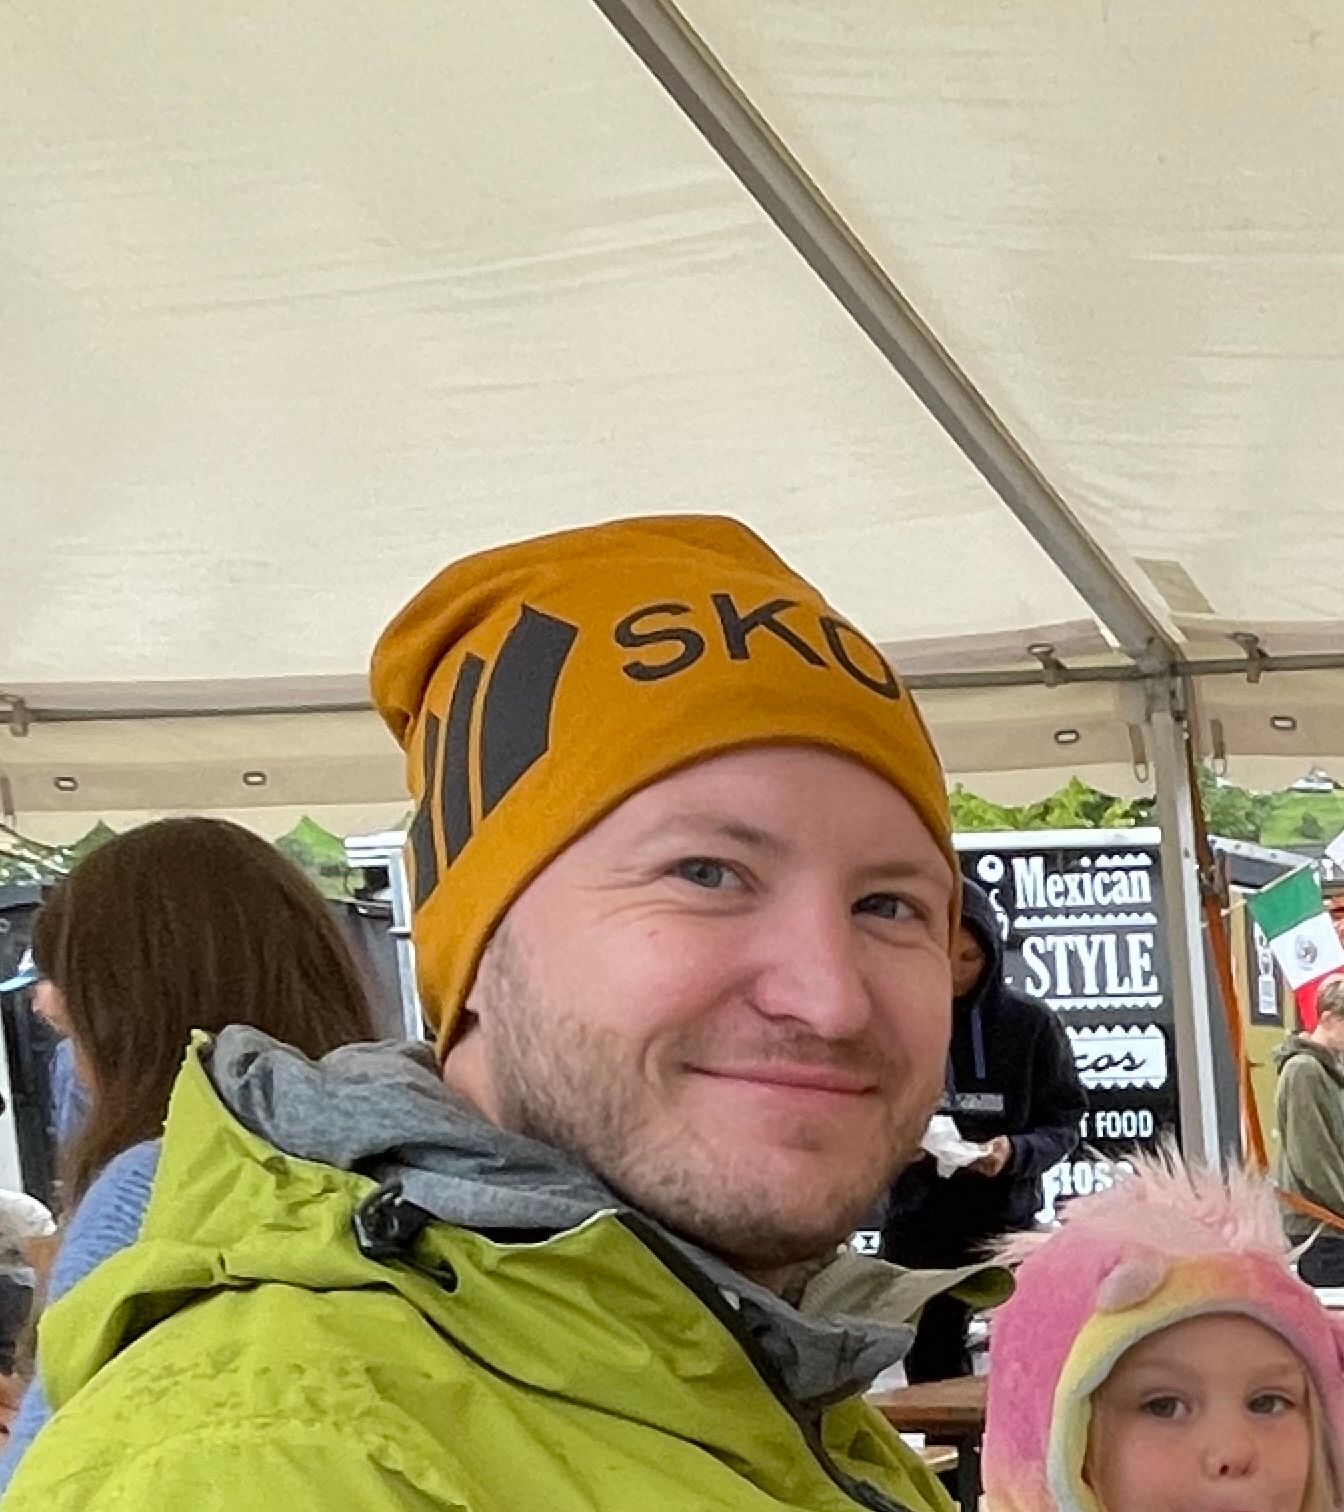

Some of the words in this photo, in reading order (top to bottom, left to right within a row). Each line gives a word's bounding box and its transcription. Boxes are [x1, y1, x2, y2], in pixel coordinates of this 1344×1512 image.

[1011, 856, 1153, 909] Mexican
[1021, 932, 1159, 998] STYLE
[1073, 1050, 1148, 1074] cos
[1094, 1108, 1154, 1139] FOOD
